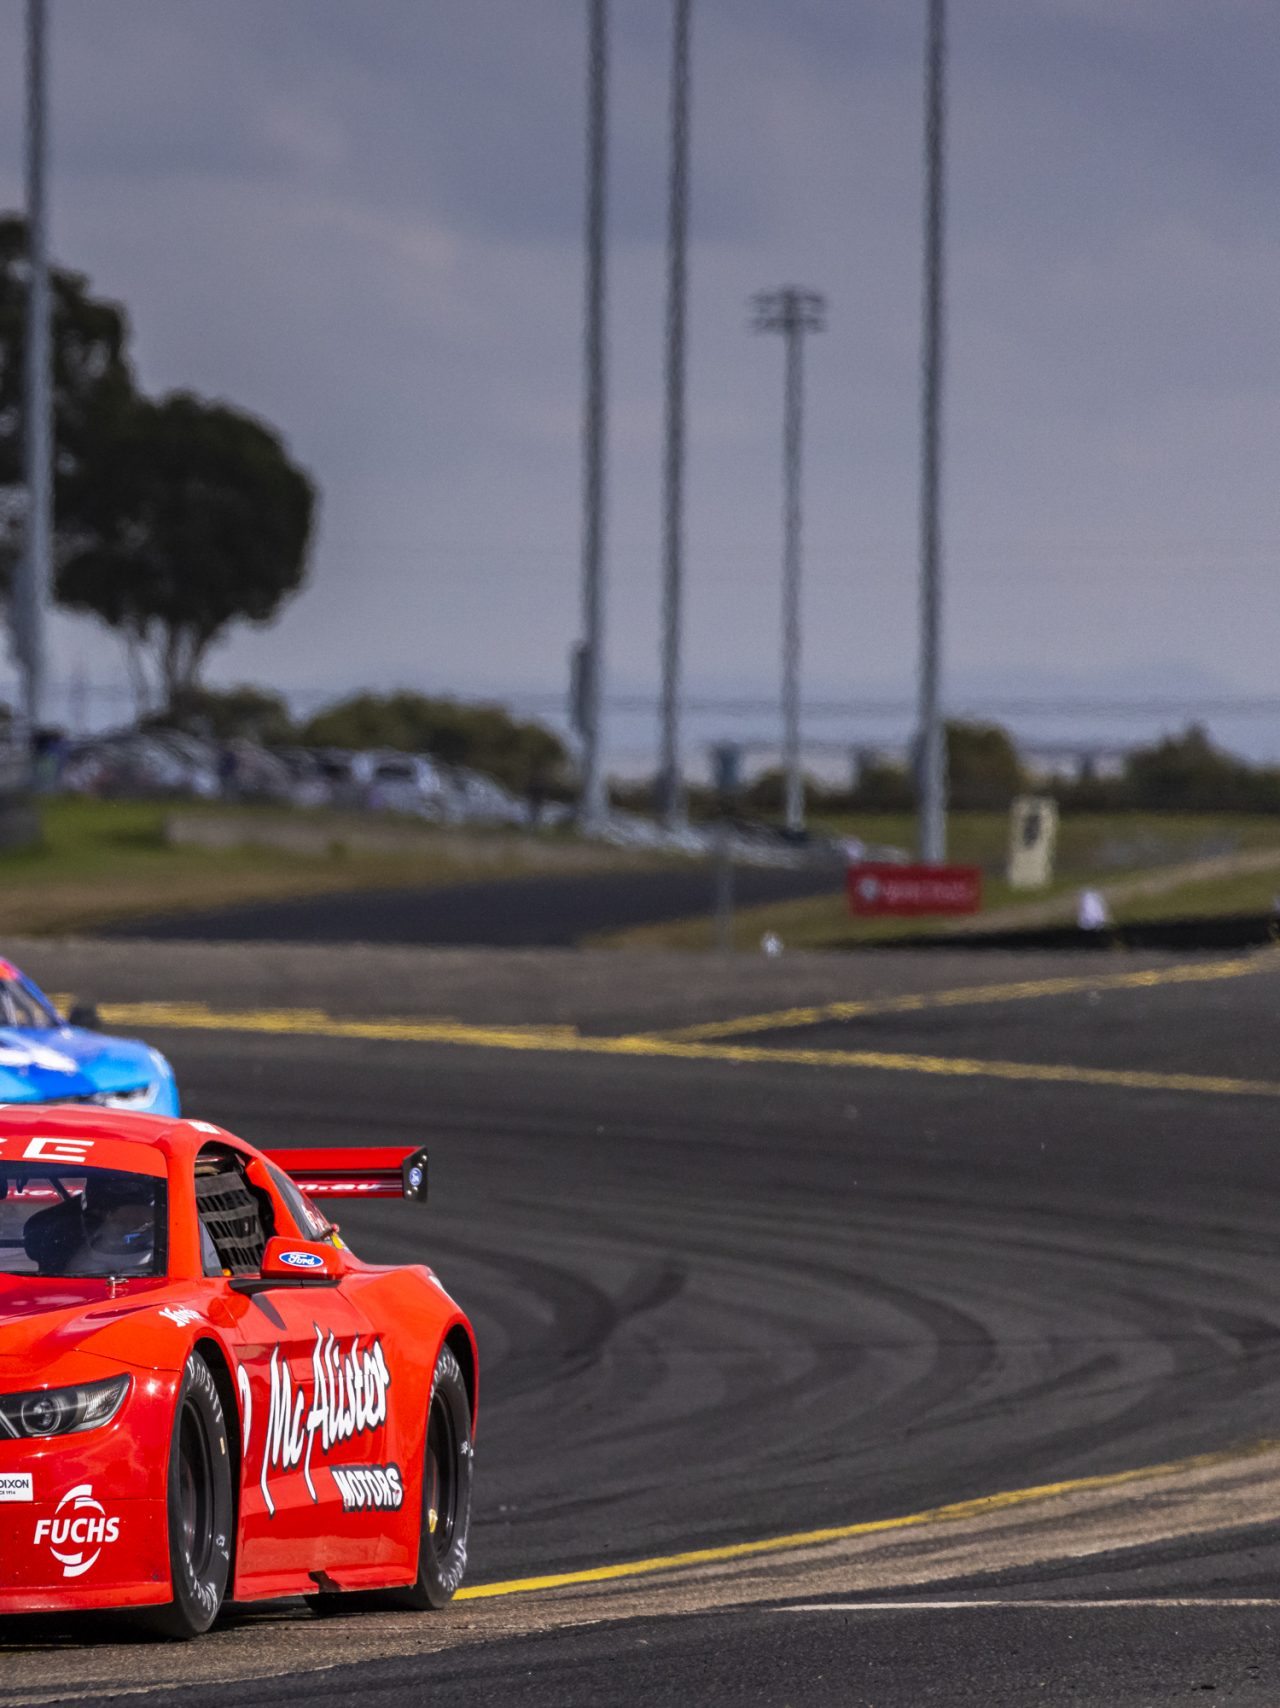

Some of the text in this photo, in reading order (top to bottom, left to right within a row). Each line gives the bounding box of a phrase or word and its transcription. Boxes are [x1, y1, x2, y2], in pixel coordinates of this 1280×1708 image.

[287, 1253, 315, 1265] Ford
[260, 1323, 391, 1519] McAlister
[329, 1463, 403, 1512] MOTORS
[33, 1517, 120, 1544] FUCHS
